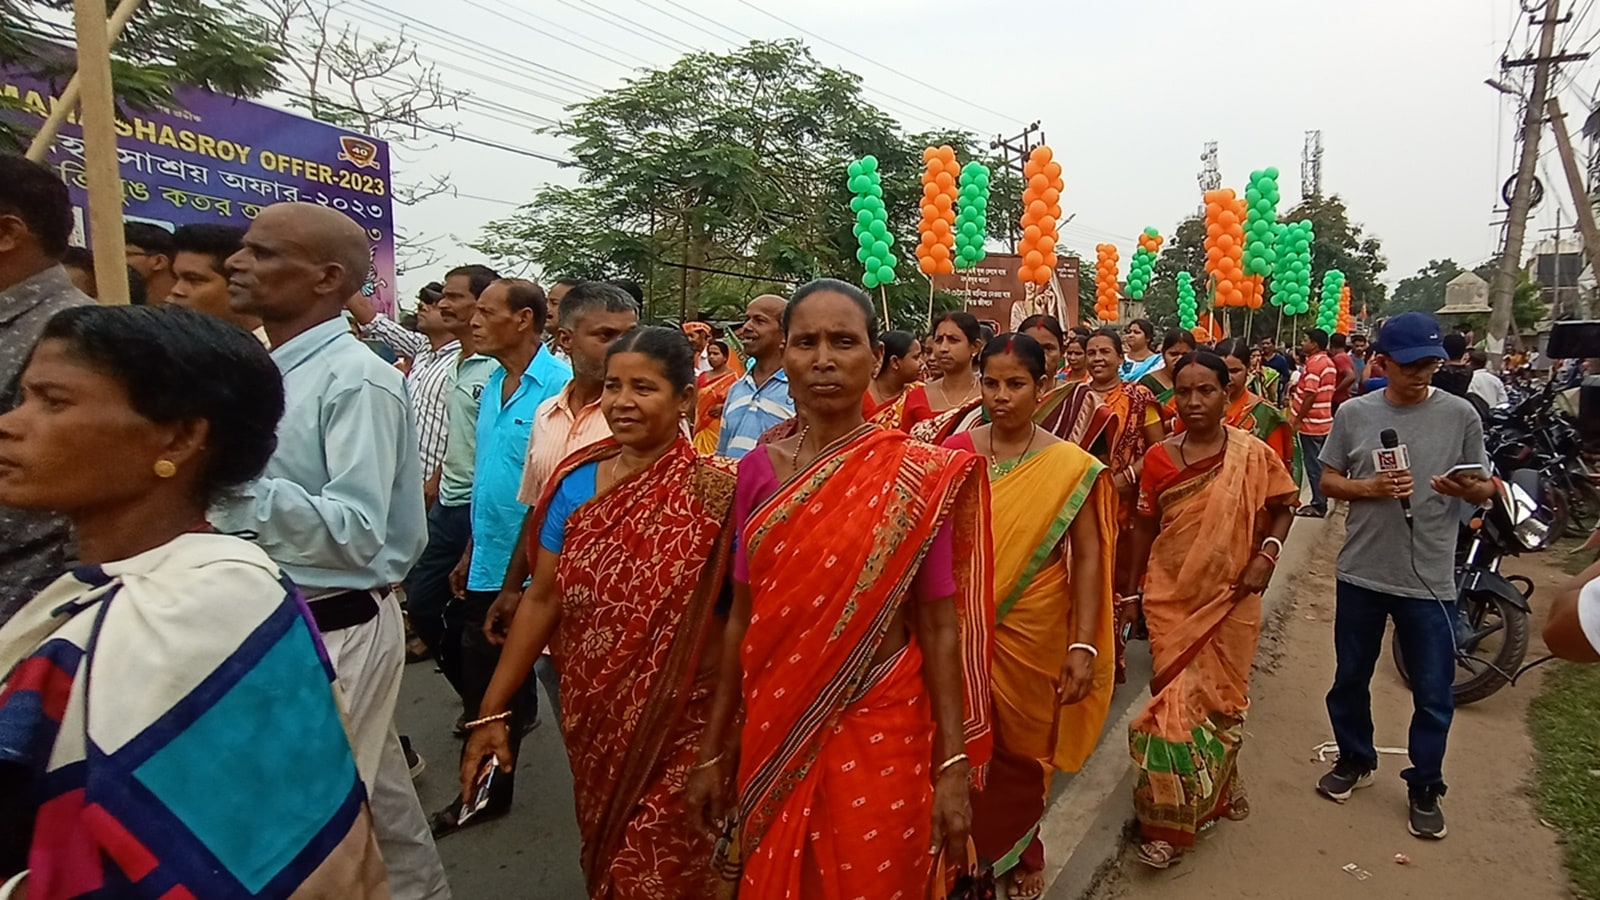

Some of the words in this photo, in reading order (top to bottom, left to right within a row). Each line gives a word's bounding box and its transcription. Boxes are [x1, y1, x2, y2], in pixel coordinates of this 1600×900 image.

[113, 117, 251, 165] SHASROY
[260, 150, 385, 196] OFFER-2023
[352, 147, 368, 156] 40
[158, 186, 232, 217] কতর
